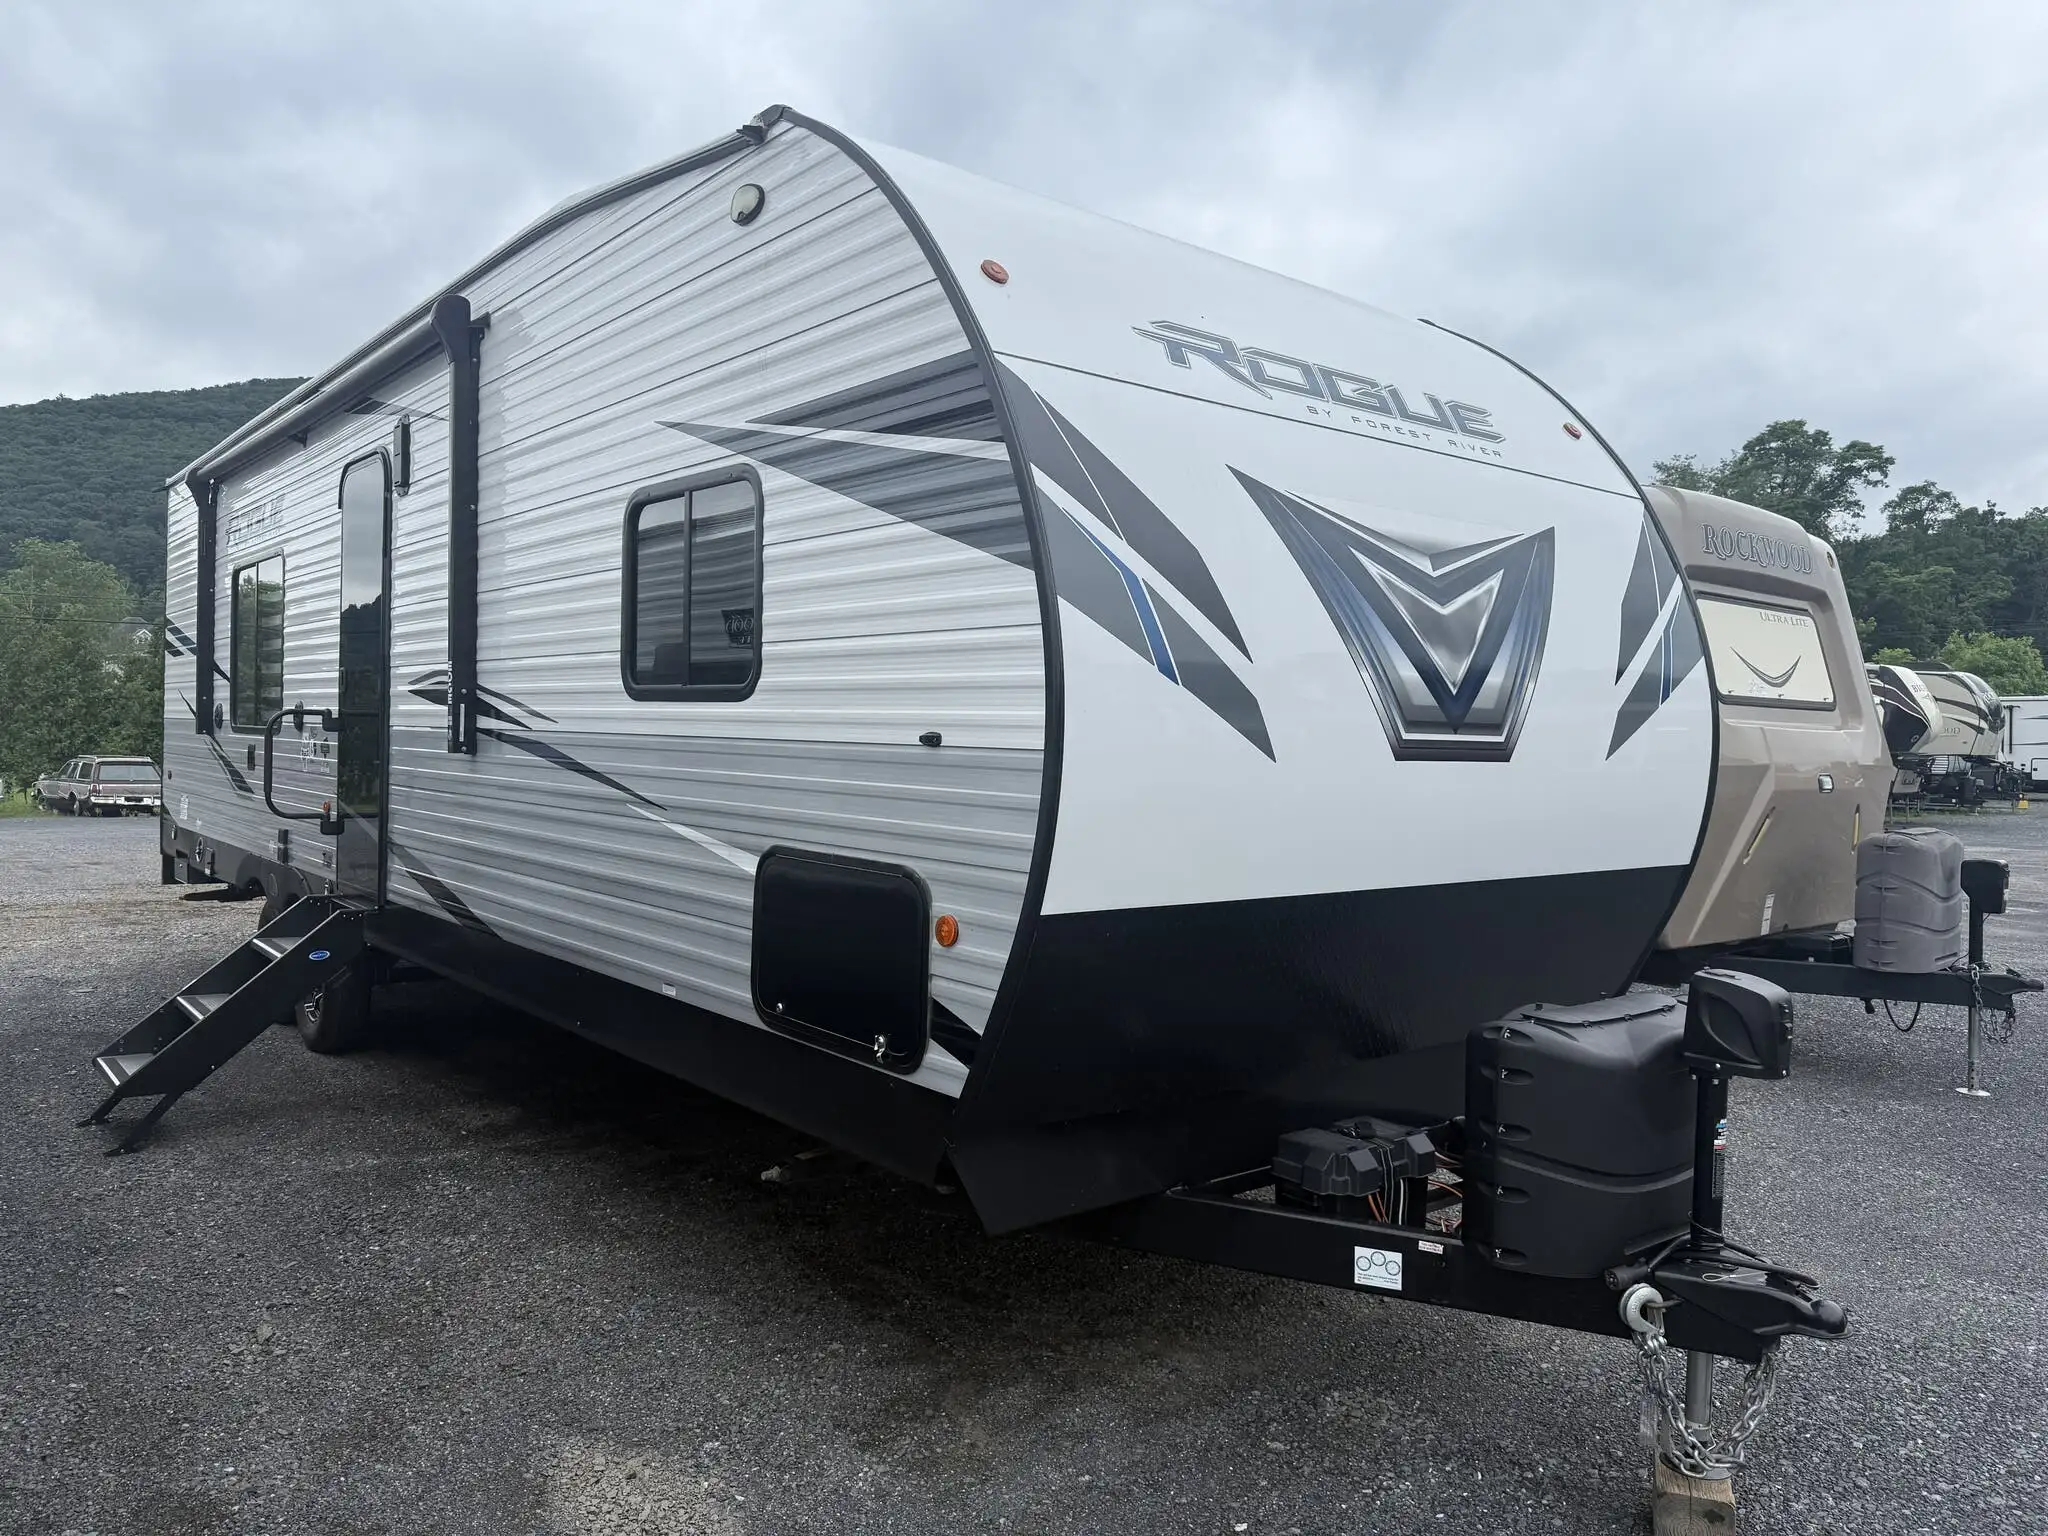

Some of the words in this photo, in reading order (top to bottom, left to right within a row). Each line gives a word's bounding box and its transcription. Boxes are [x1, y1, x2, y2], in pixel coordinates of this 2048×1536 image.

[1131, 320, 1506, 444] ROGUE
[1306, 405, 1332, 419] BY
[1351, 414, 1433, 442] FOREST
[1447, 438, 1503, 458] RIVER
[1701, 523, 1813, 575] ROCKWOOD
[1759, 611, 1790, 625] ULTRA
[1791, 616, 1809, 628] LITE
